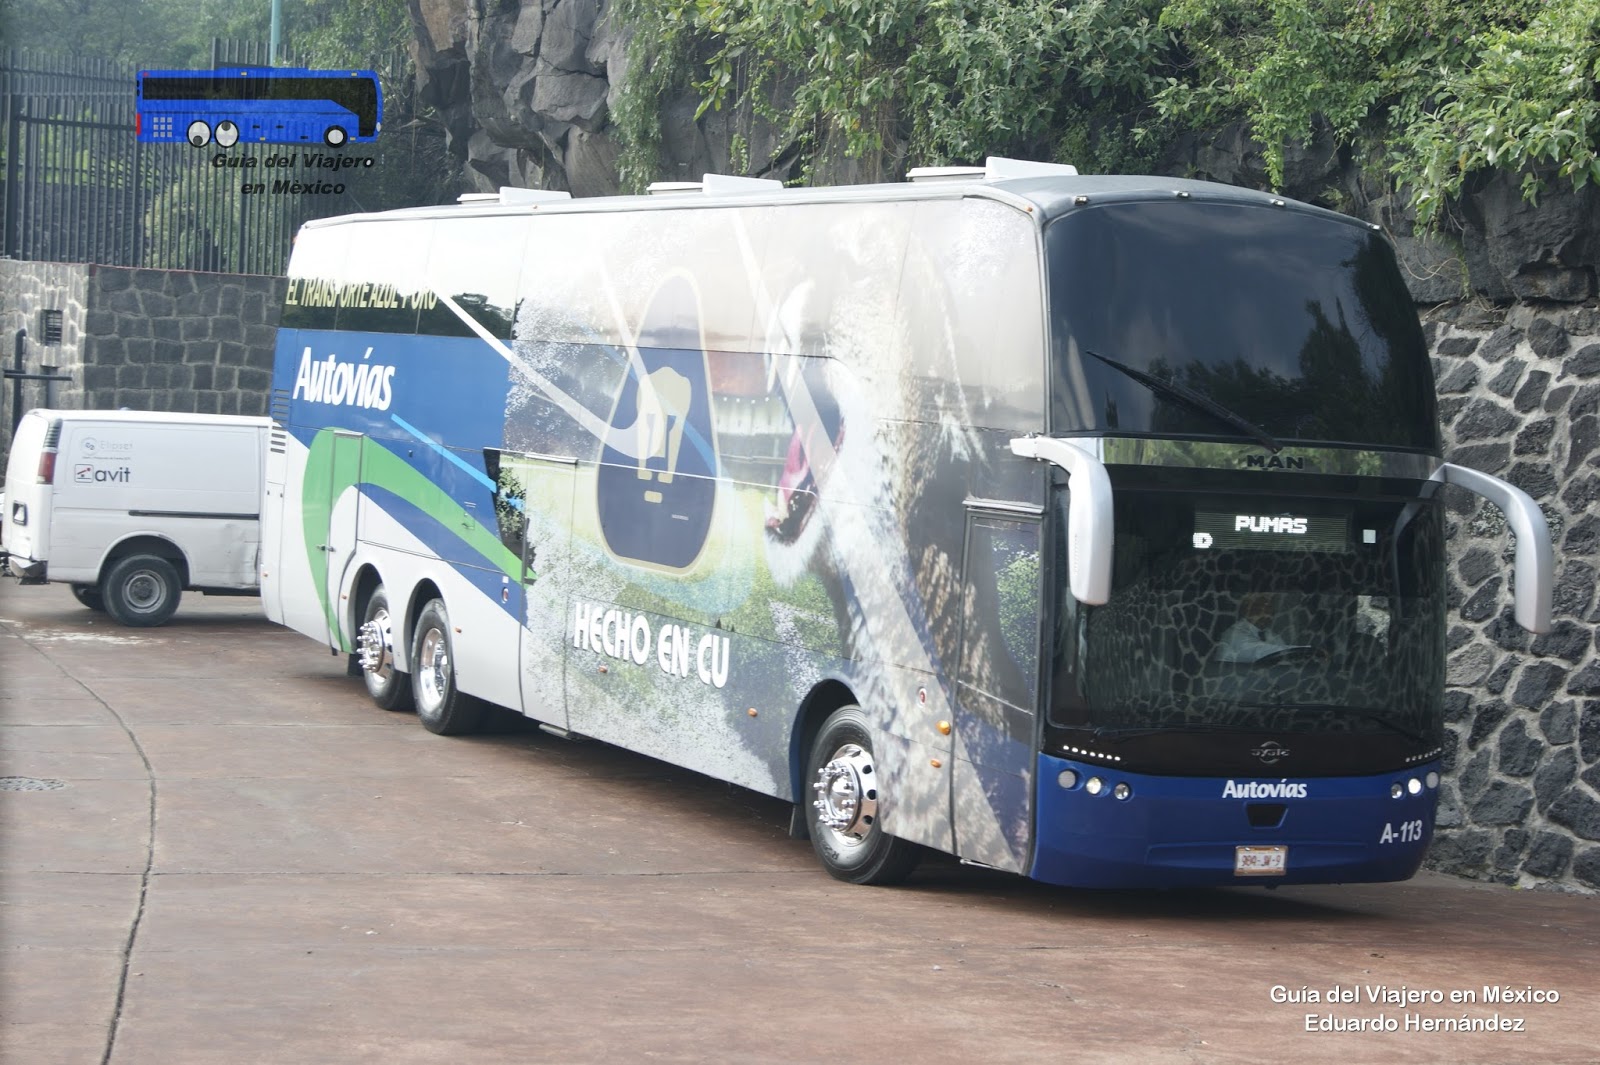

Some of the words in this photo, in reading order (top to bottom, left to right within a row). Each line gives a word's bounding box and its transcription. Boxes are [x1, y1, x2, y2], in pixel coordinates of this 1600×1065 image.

[285, 278, 299, 306] EL
[368, 282, 399, 310] AZUL
[292, 346, 396, 411] Autovías
[1246, 454, 1304, 469] MAN
[94, 467, 131, 482] avit
[1235, 515, 1308, 534] PUMAS
[573, 601, 651, 665] HECHO
[657, 623, 690, 679] EN
[696, 633, 730, 689] CU
[1221, 778, 1308, 799] Autovías
[1379, 819, 1423, 844] A-113
